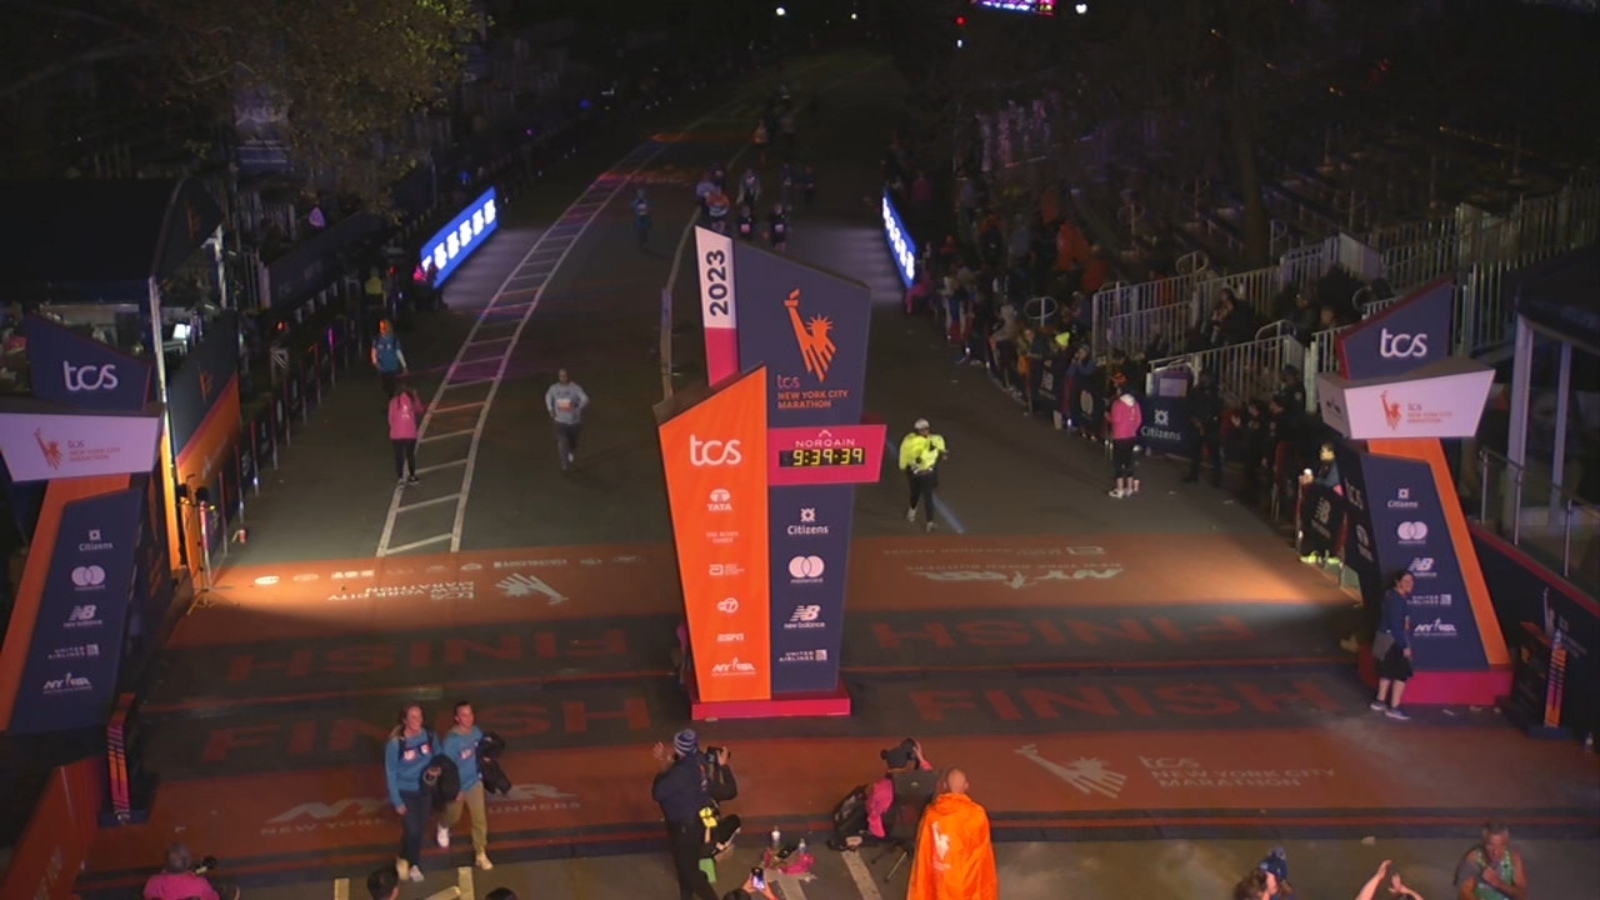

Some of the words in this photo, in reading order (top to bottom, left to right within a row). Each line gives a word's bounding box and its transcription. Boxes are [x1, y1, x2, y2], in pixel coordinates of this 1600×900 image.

[706, 250, 729, 316] 2023
[1380, 327, 1428, 358] tcs
[63, 360, 118, 391] tcs
[777, 375, 800, 389] tcs
[778, 392, 800, 400] NEW
[802, 390, 826, 399] YORK
[828, 389, 849, 398] CITY
[778, 400, 831, 409] MARATHON
[1140, 426, 1181, 441] Citizens
[795, 438, 855, 448] NORQAIN
[689, 434, 742, 466] tcs
[1387, 500, 1418, 508] Citizens
[787, 525, 829, 535] Citizens
[78, 542, 113, 551] Citizens
[871, 615, 1254, 650] FINISH
[229, 628, 627, 681] FINISH
[910, 681, 1337, 723] FINISH
[1138, 755, 1200, 768] tcs
[1151, 770, 1207, 779] NEW
[1213, 769, 1280, 778] YORK
[1284, 768, 1335, 777] CITY
[1158, 778, 1302, 787] MARATHON
[486, 802, 581, 816] UNNERS
[261, 824, 317, 836] NEW
